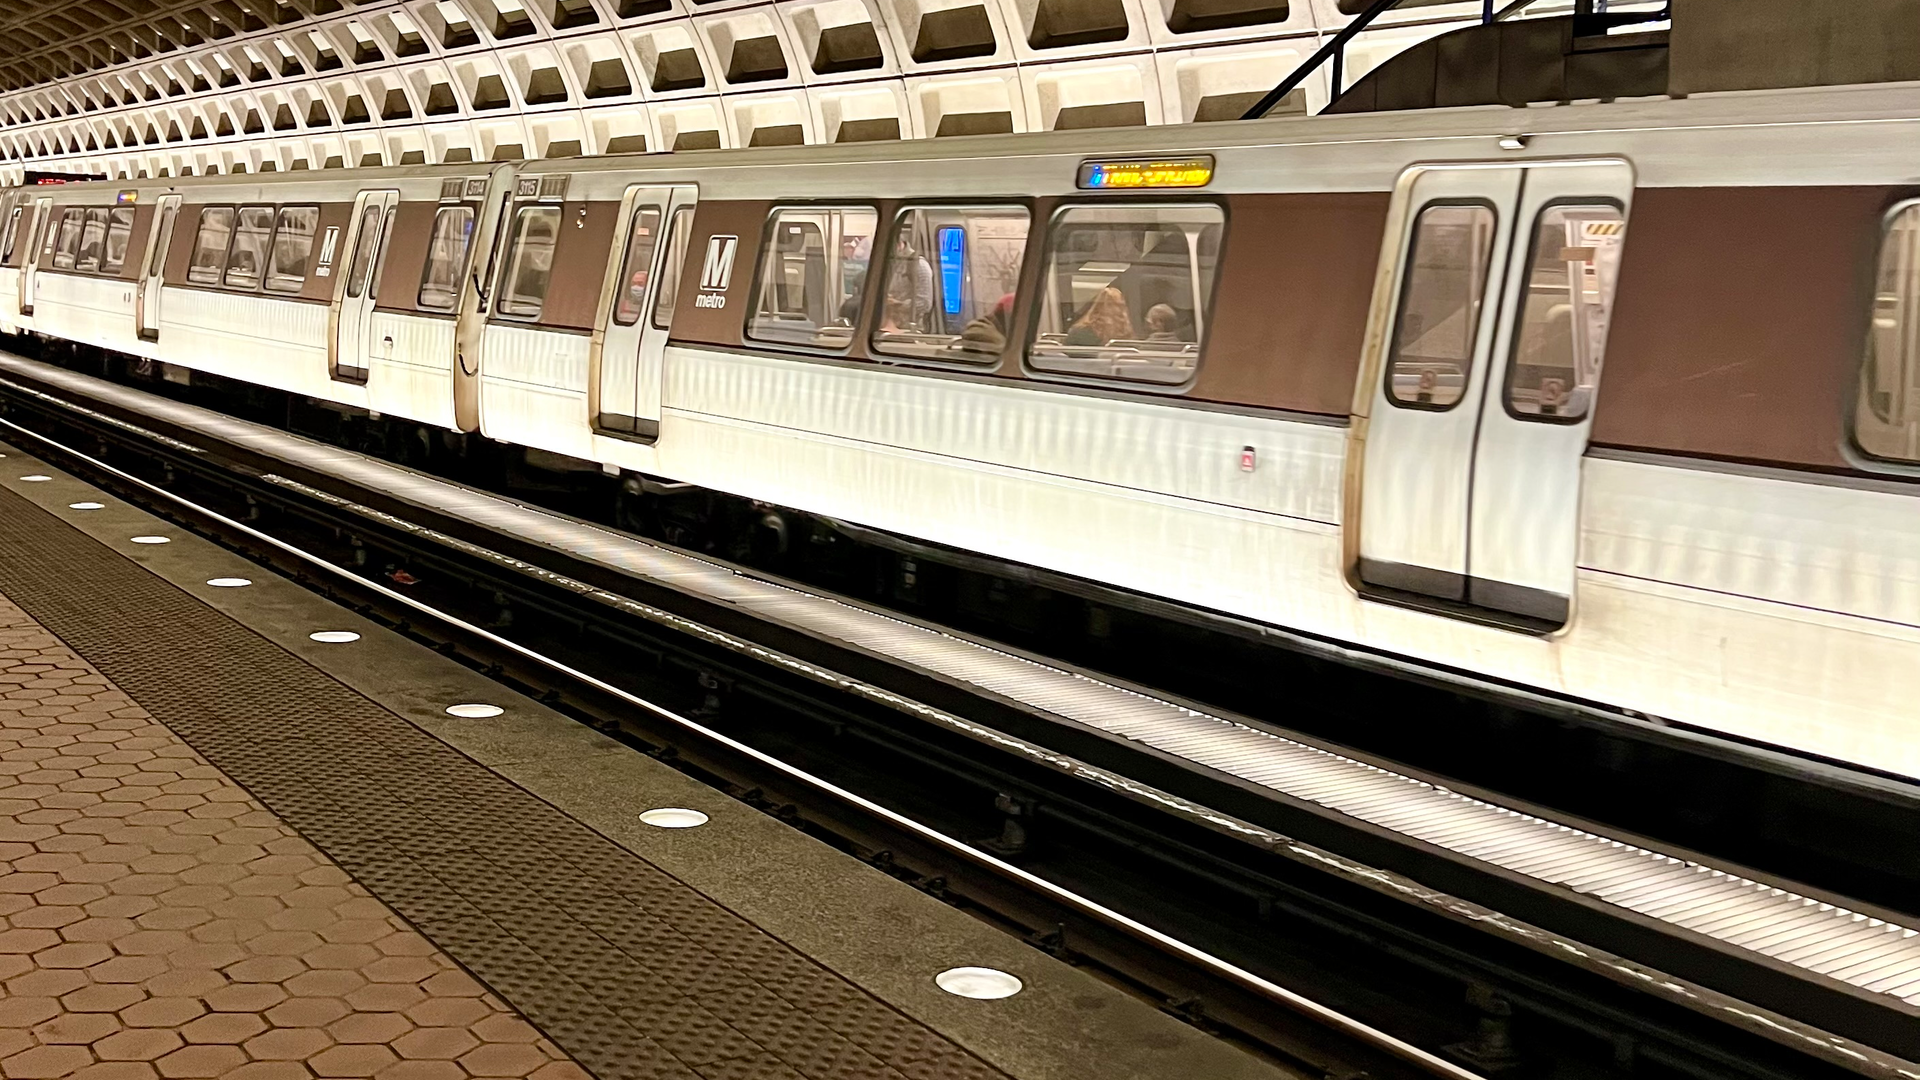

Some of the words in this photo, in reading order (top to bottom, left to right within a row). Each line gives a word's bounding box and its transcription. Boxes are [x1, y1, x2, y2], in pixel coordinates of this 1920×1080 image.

[320, 228, 340, 263] M
[701, 238, 737, 288] M
[694, 292, 726, 309] metro
